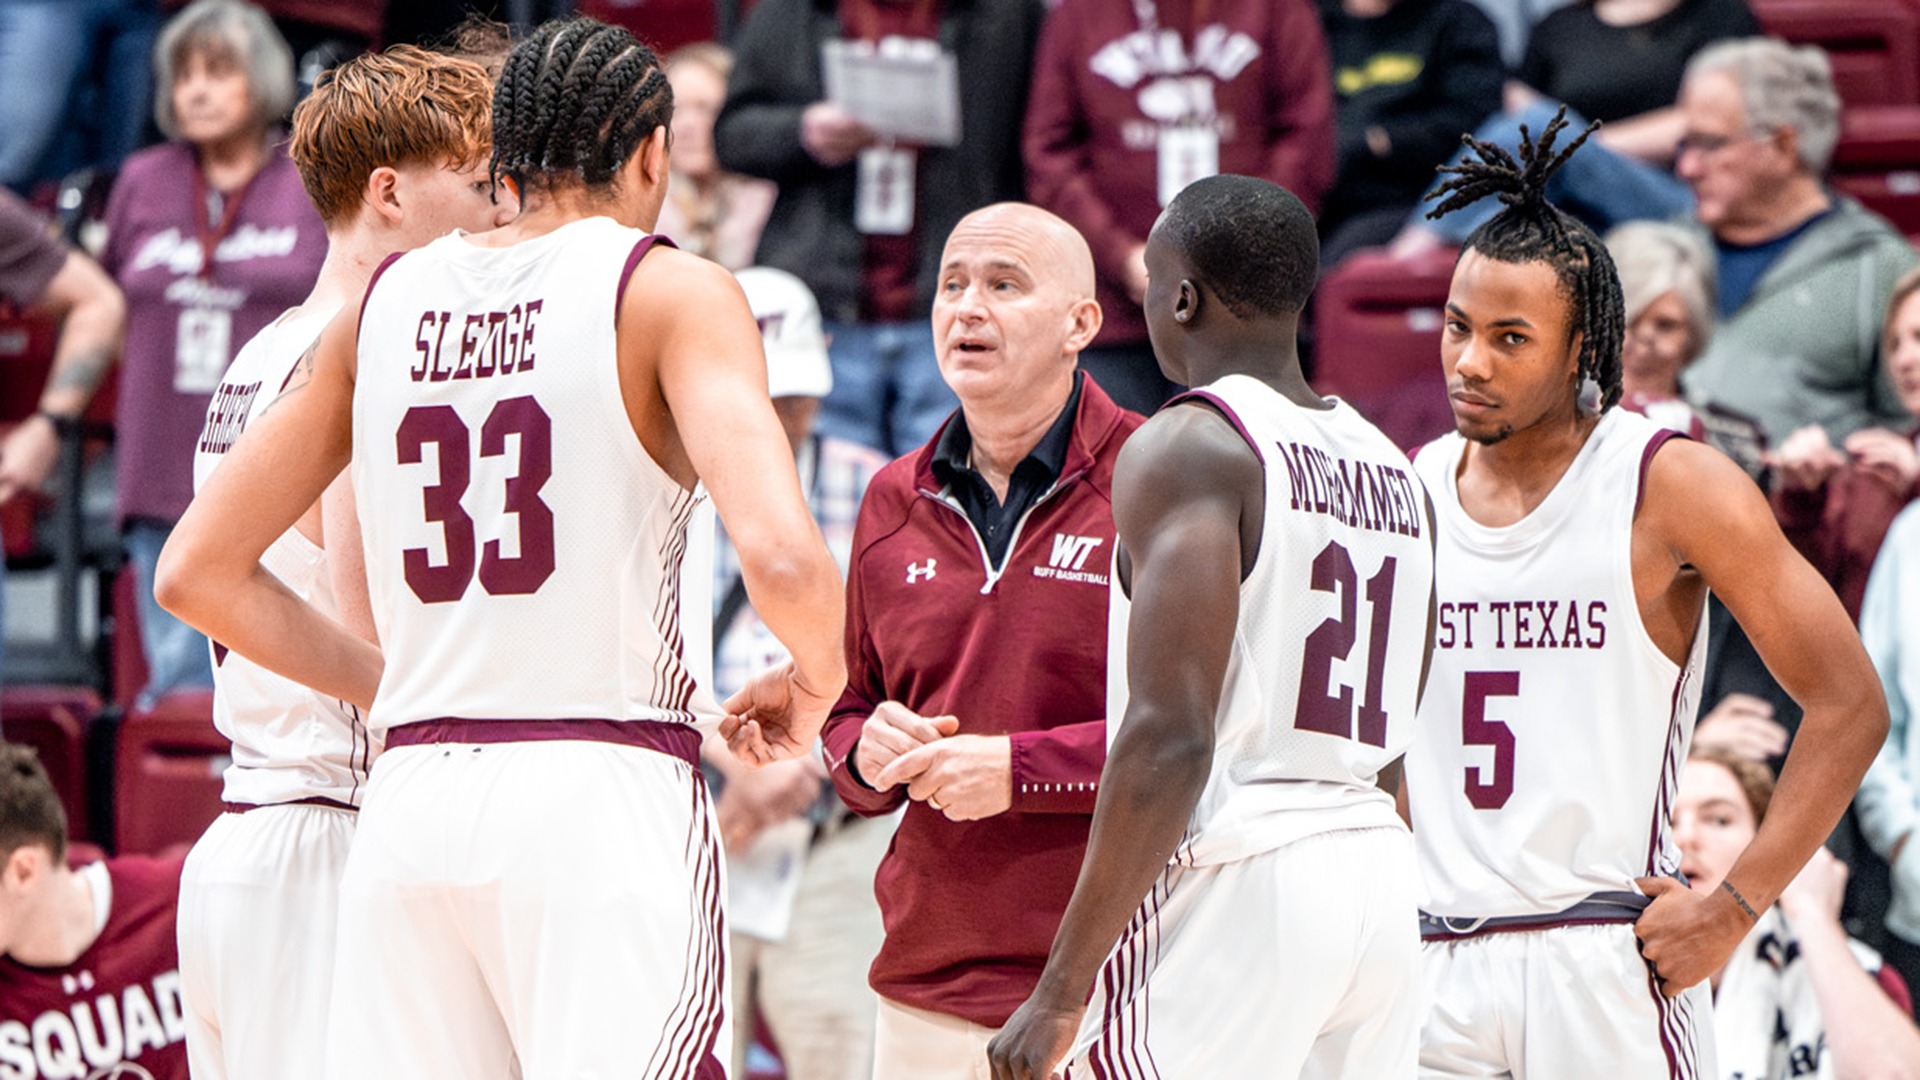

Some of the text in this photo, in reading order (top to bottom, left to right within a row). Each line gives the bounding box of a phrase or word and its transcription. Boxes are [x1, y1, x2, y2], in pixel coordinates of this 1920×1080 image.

[410, 299, 544, 382] SLEDGE
[396, 395, 556, 605] 33
[1276, 441, 1420, 539] MOHAMMED
[1033, 566, 1108, 585] BUFF BASKETBALL
[1049, 533, 1103, 570] WT
[1294, 540, 1397, 749] 21
[1434, 600, 1607, 649] ST TEXAS
[1462, 671, 1520, 809] 5
[0, 969, 186, 1080] SQUAD
